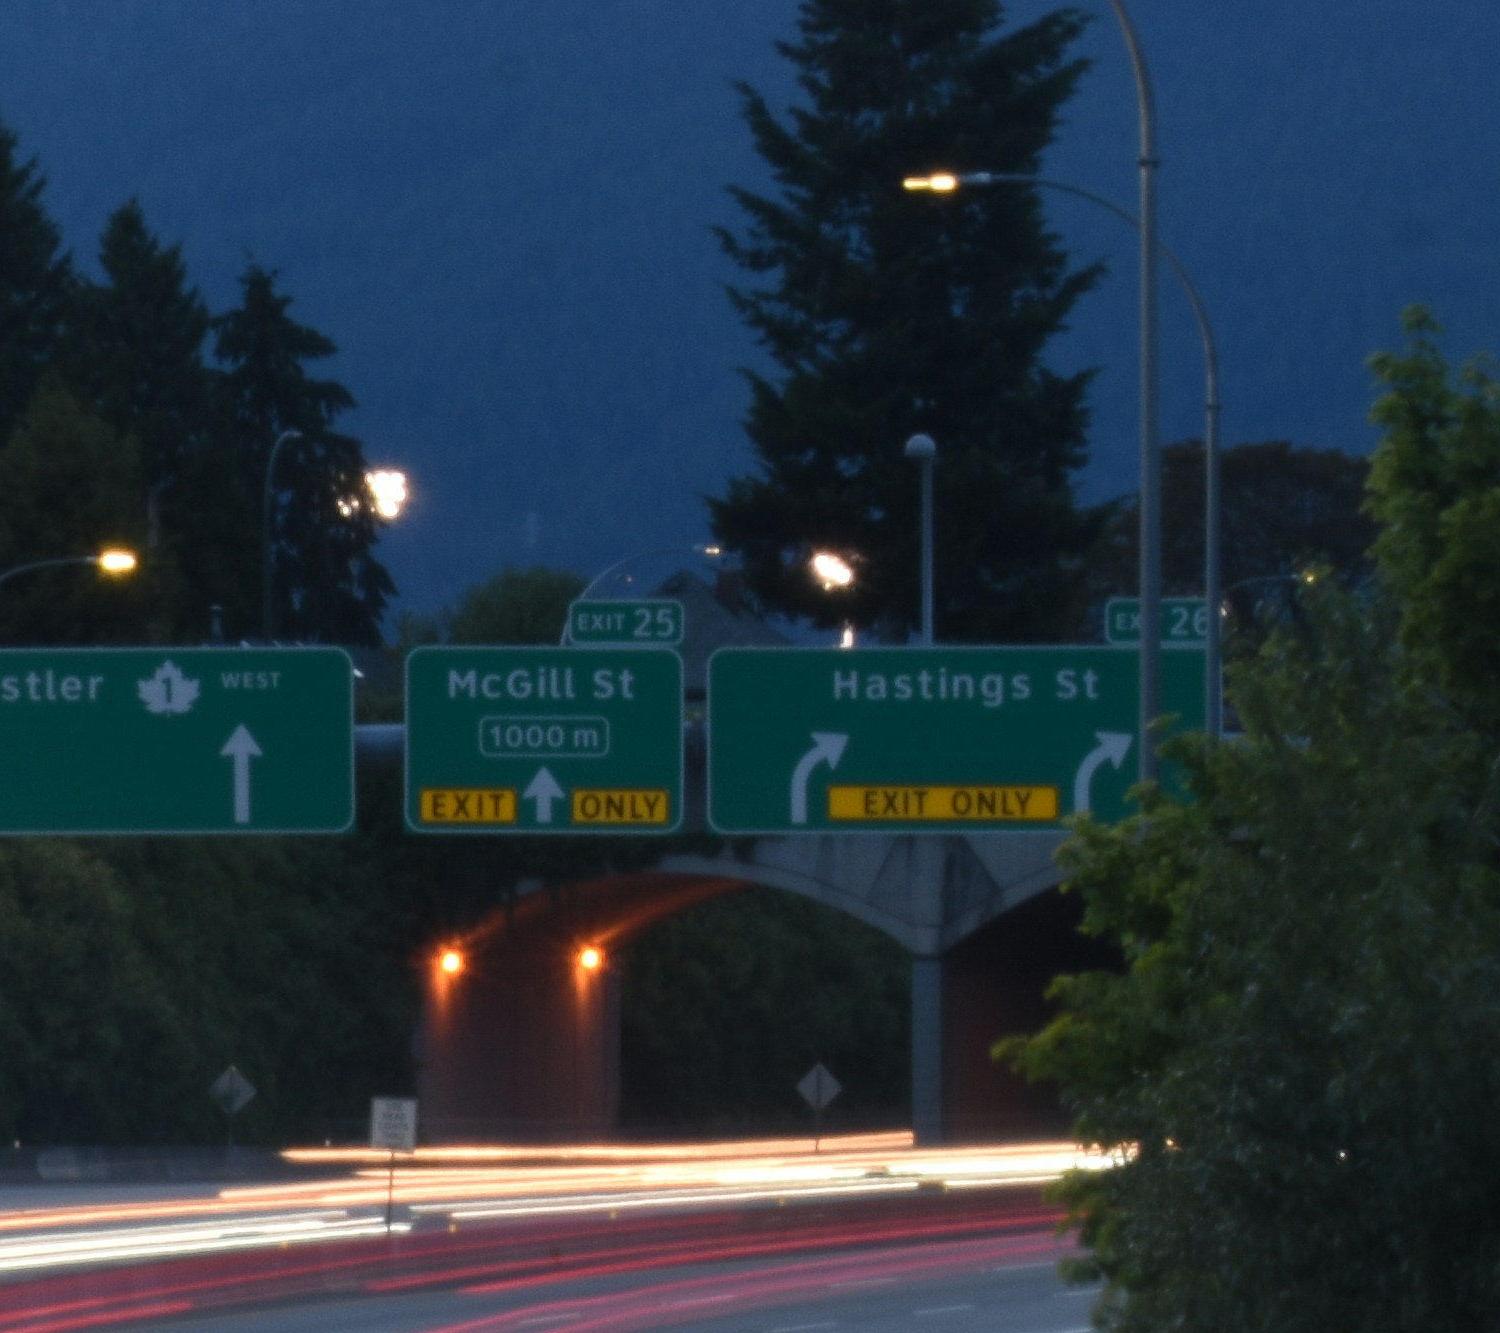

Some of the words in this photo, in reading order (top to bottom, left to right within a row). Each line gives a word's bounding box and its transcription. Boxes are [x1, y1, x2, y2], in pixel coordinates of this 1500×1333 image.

[577, 613, 626, 631] EXIT
[632, 608, 675, 638] 25
[160, 677, 173, 704] 1
[220, 671, 282, 689] WEST
[448, 667, 576, 699] McGill
[593, 668, 635, 700] St
[833, 667, 1032, 707] Hastings
[1055, 669, 1100, 700] St
[489, 725, 565, 748] 1000
[573, 728, 599, 748] m
[431, 793, 505, 818] EXIT
[579, 793, 662, 818] ONLY
[863, 791, 929, 816] EXIT
[951, 790, 1033, 816] ONLY
